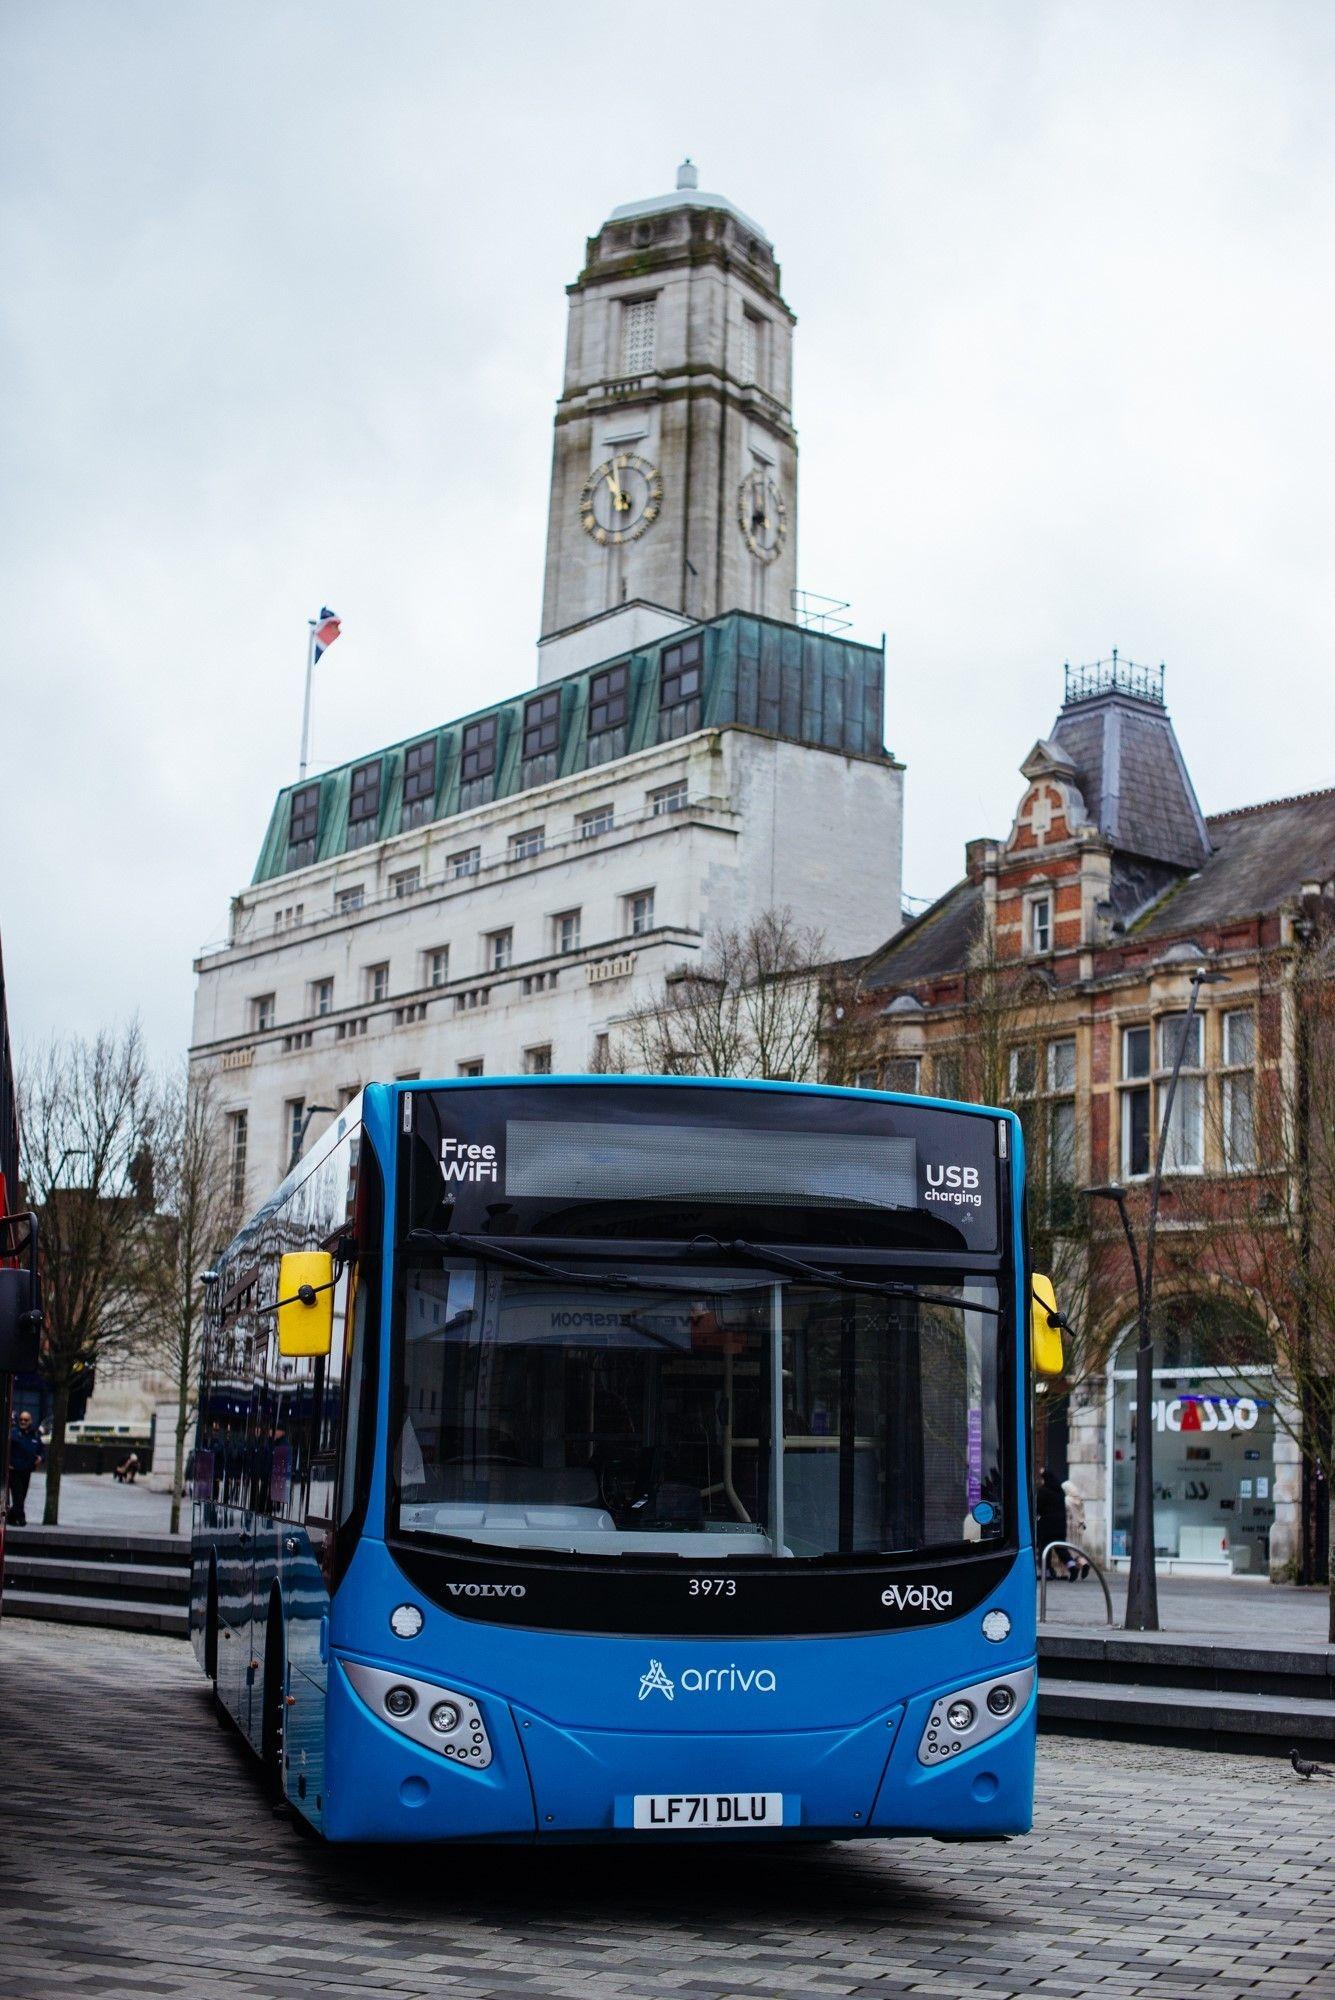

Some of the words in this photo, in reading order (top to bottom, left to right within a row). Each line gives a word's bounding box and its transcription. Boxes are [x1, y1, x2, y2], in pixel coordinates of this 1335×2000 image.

[441, 1138, 496, 1160] Free
[439, 1161, 498, 1182] WiFi
[926, 1164, 979, 1189] USB
[924, 1188, 982, 1207] charging
[446, 1583, 526, 1598] VOLVO
[688, 1579, 736, 1596] 3973
[681, 1663, 776, 1692] arriva
[650, 1798, 708, 1823] LF71
[716, 1796, 766, 1822] DLU
